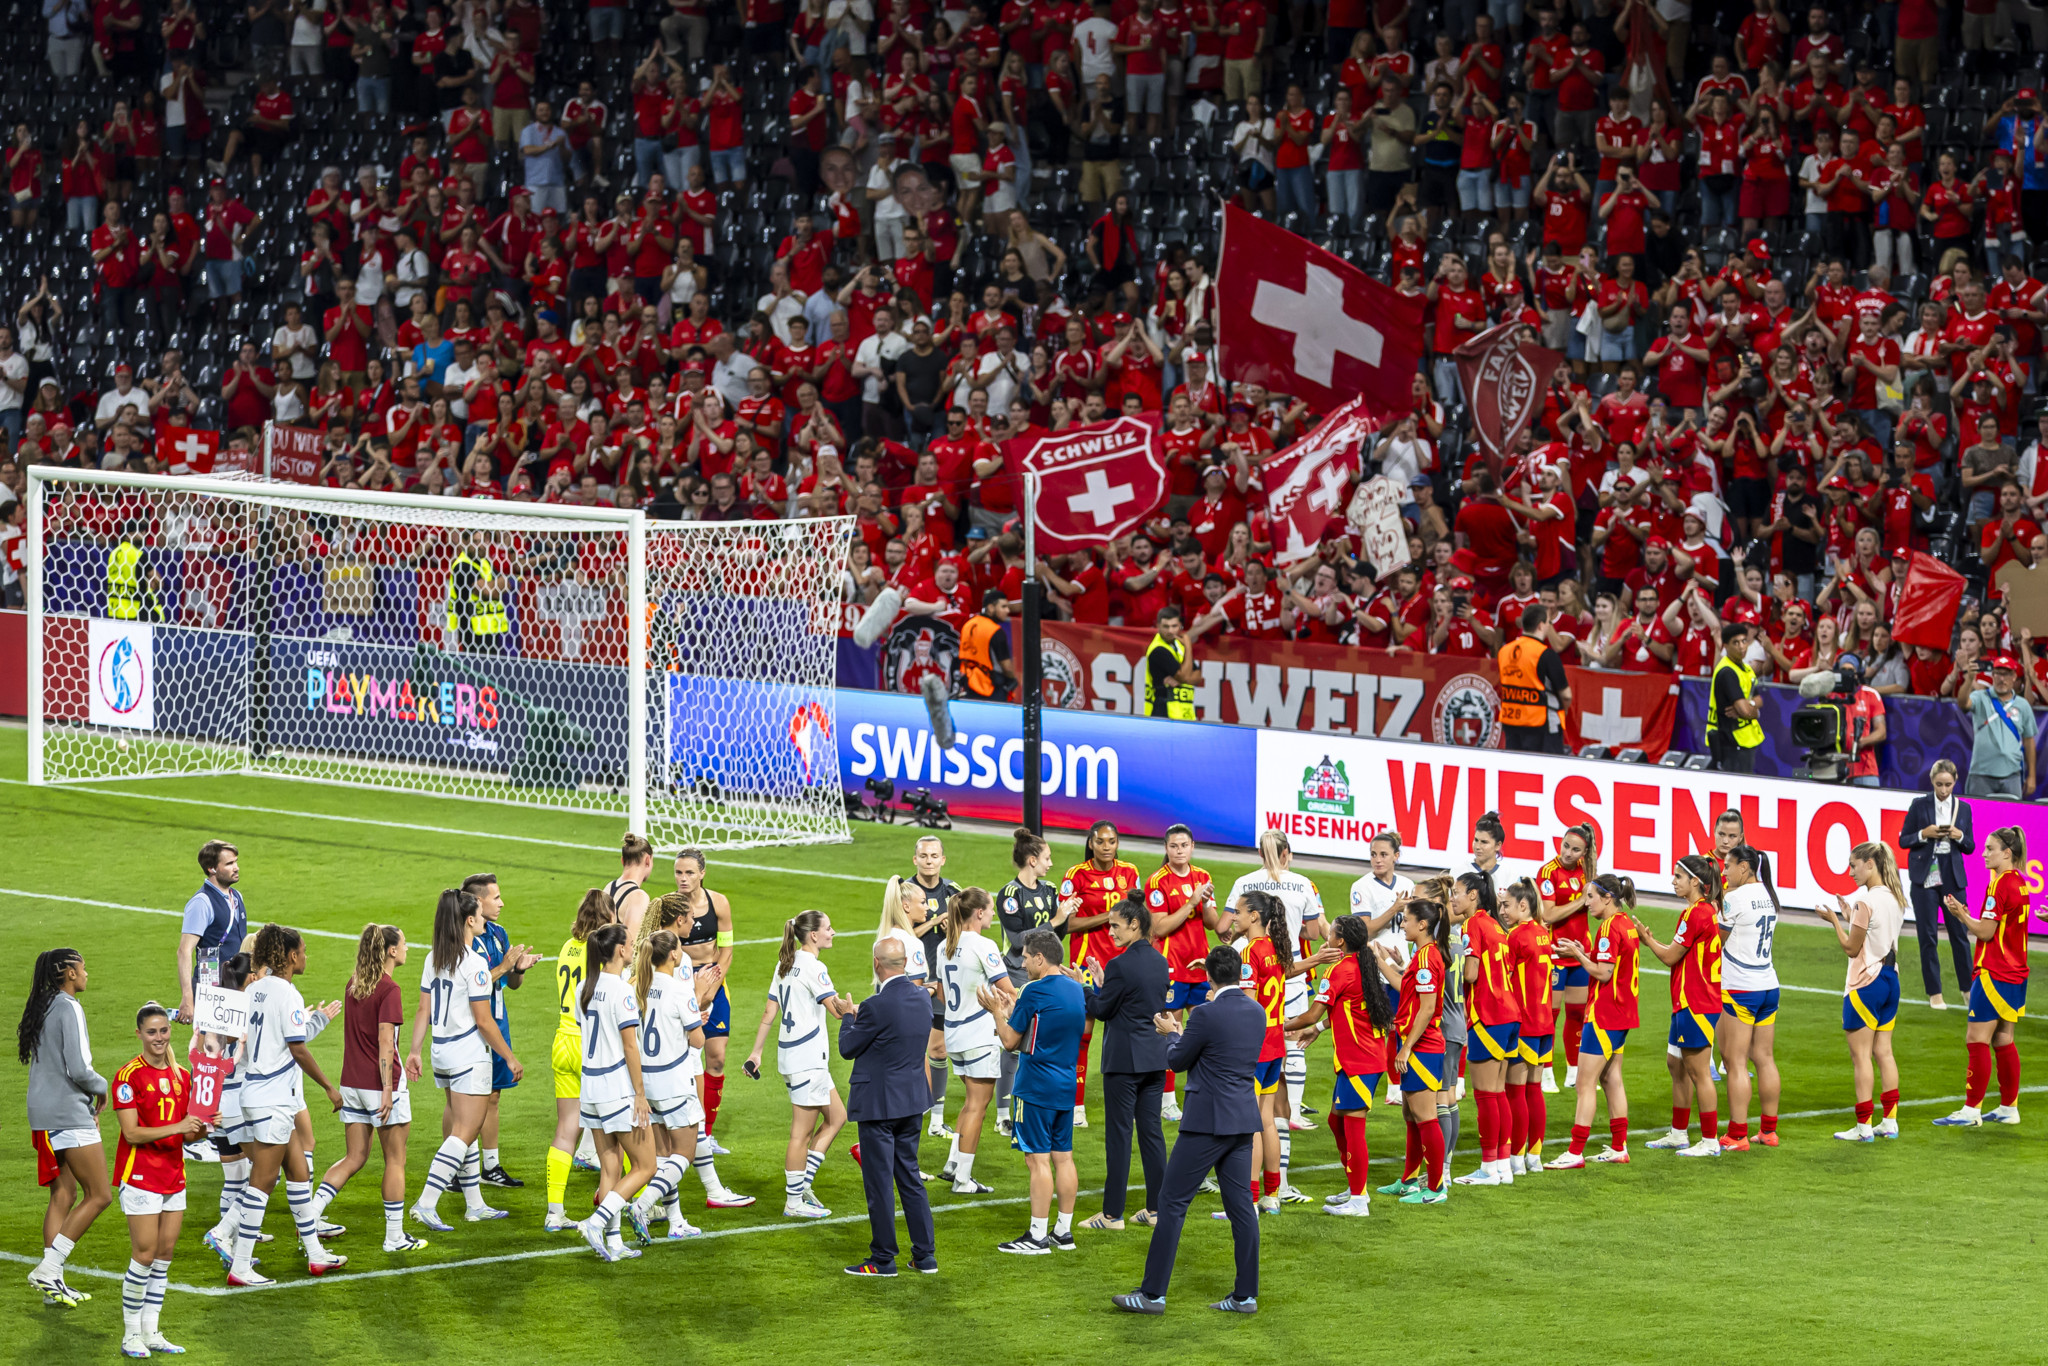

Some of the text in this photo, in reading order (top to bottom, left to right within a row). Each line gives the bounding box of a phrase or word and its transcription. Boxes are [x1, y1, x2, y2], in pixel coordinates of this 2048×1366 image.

[270, 428, 288, 450] OU
[1041, 429, 1137, 466] SCHWEIZ
[1458, 632, 1473, 649] 10
[307, 650, 338, 667] UEFA
[307, 669, 499, 729] PLAYMAKERS
[851, 722, 1119, 801] swisscom
[1307, 801, 1345, 814] ORIGINAL
[1751, 899, 1774, 910] BALLES
[1536, 935, 1550, 946] OLGA
[1756, 915, 1776, 958] 15
[945, 964, 961, 1012] 5
[1538, 954, 1552, 1005] 7
[1630, 948, 1640, 997] 8
[254, 991, 267, 1004] SOW
[430, 977, 453, 1027] 17
[214, 1006, 247, 1027] GOTTI
[586, 1009, 599, 1059] 7
[193, 1074, 215, 1107] 18
[157, 1097, 176, 1121] 17
